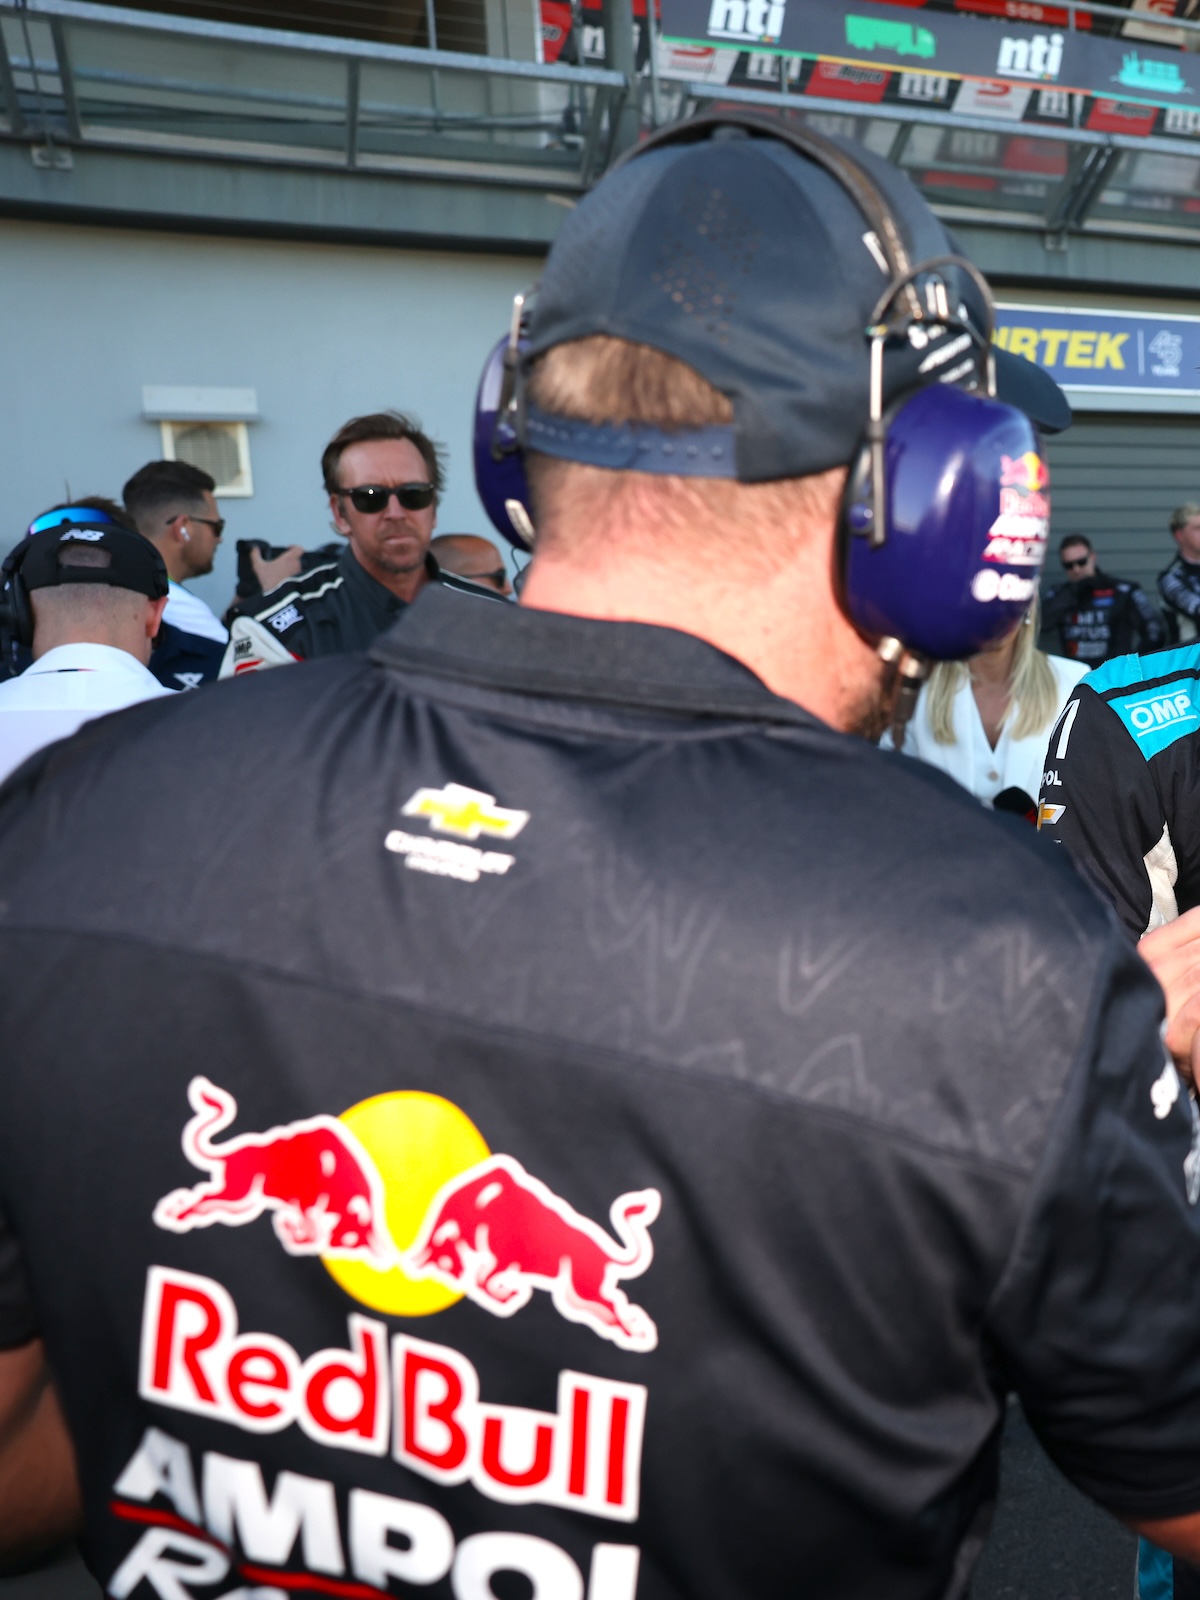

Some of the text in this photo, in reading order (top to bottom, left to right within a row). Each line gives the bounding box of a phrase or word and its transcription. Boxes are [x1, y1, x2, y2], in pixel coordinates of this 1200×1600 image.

[999, 33, 1065, 75] nti
[992, 326, 1130, 371] IRTEK
[1130, 694, 1192, 730] OMP
[138, 1264, 649, 1524] Red Bull
